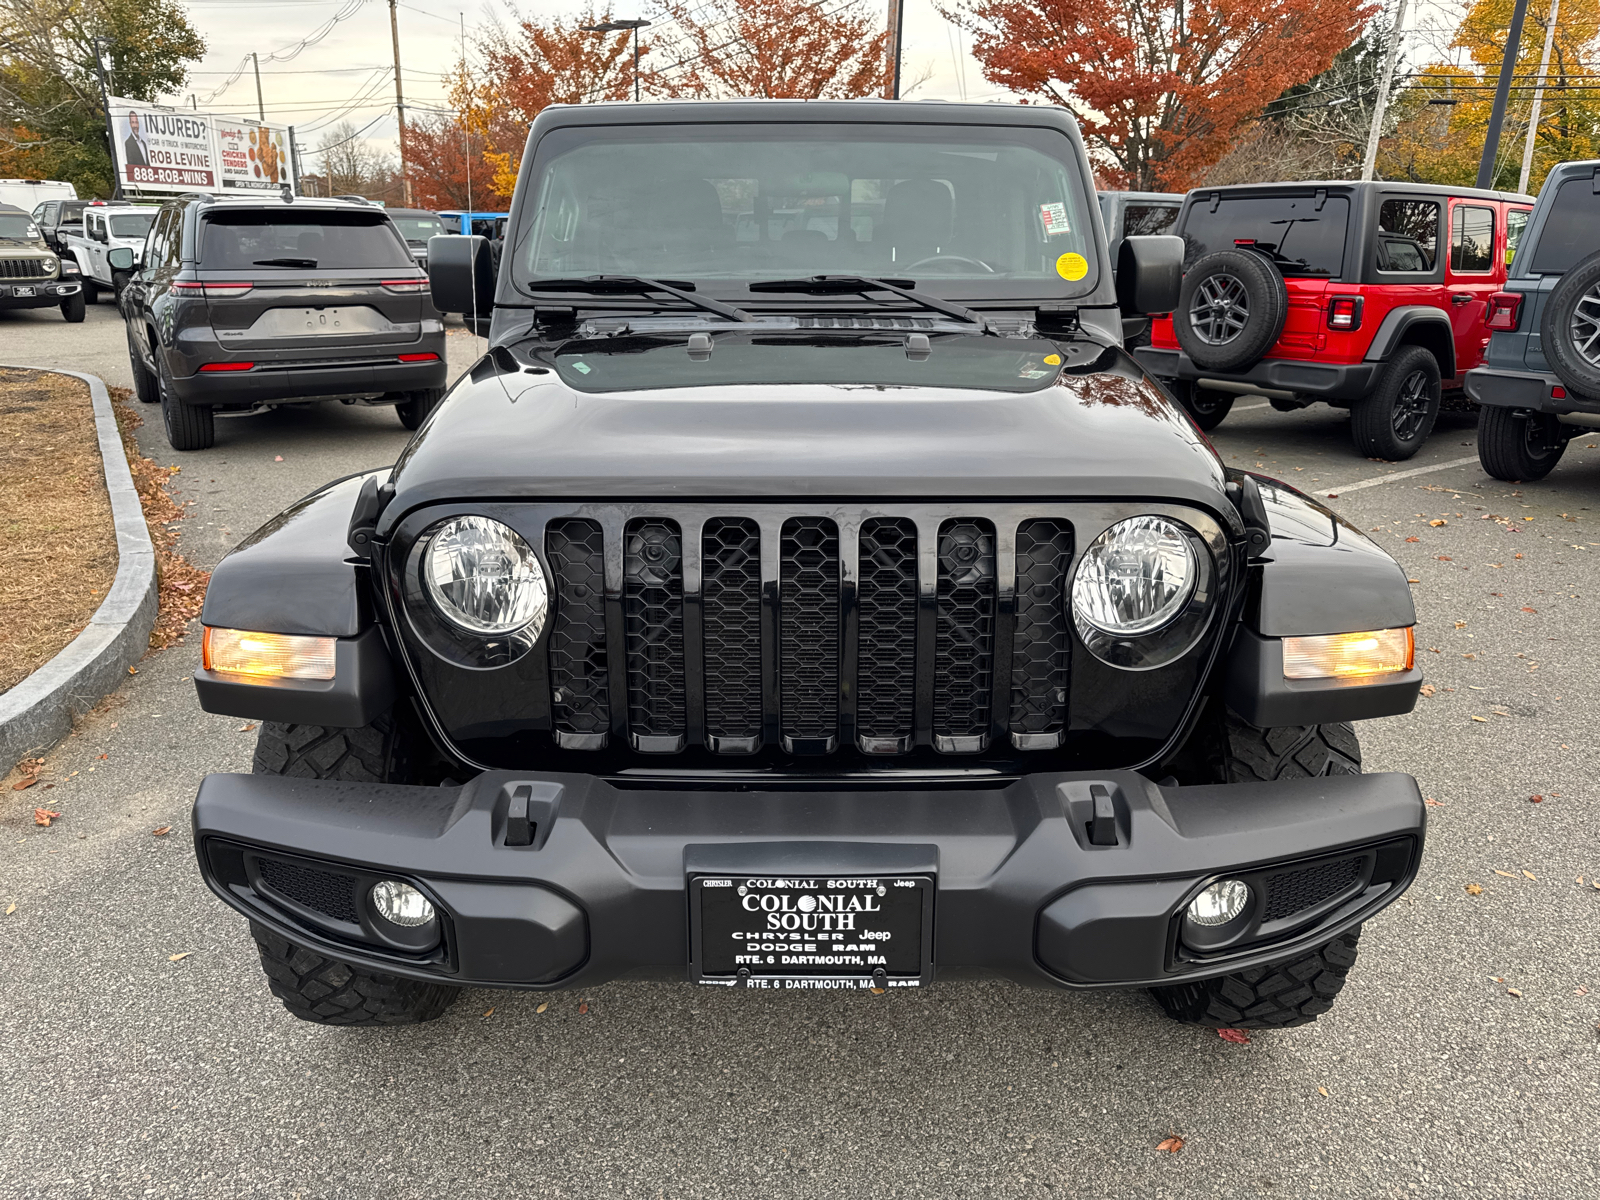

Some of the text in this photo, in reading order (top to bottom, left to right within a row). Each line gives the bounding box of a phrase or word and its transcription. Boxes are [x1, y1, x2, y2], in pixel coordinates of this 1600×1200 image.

[144, 113, 206, 140] INJURED?
[149, 150, 210, 167] ROB LEVINE
[222, 150, 247, 159] CHICKEN
[223, 159, 248, 168] TENDERS
[133, 167, 208, 184] 888-ROB-WINS
[702, 879, 733, 888] CHRYSLER
[746, 879, 878, 889] COLONIAL SOUTH
[893, 879, 916, 888] Jeep
[742, 894, 881, 912] COLONIAL
[767, 912, 856, 930] SOUTH
[731, 929, 891, 942] CHRYSLER Jeep
[746, 943, 817, 951] DODGE
[735, 955, 887, 966] RTE. 6 DARTMOUTH, MA
[746, 979, 876, 990] RTE. 6 DARTMOUTH, MA
